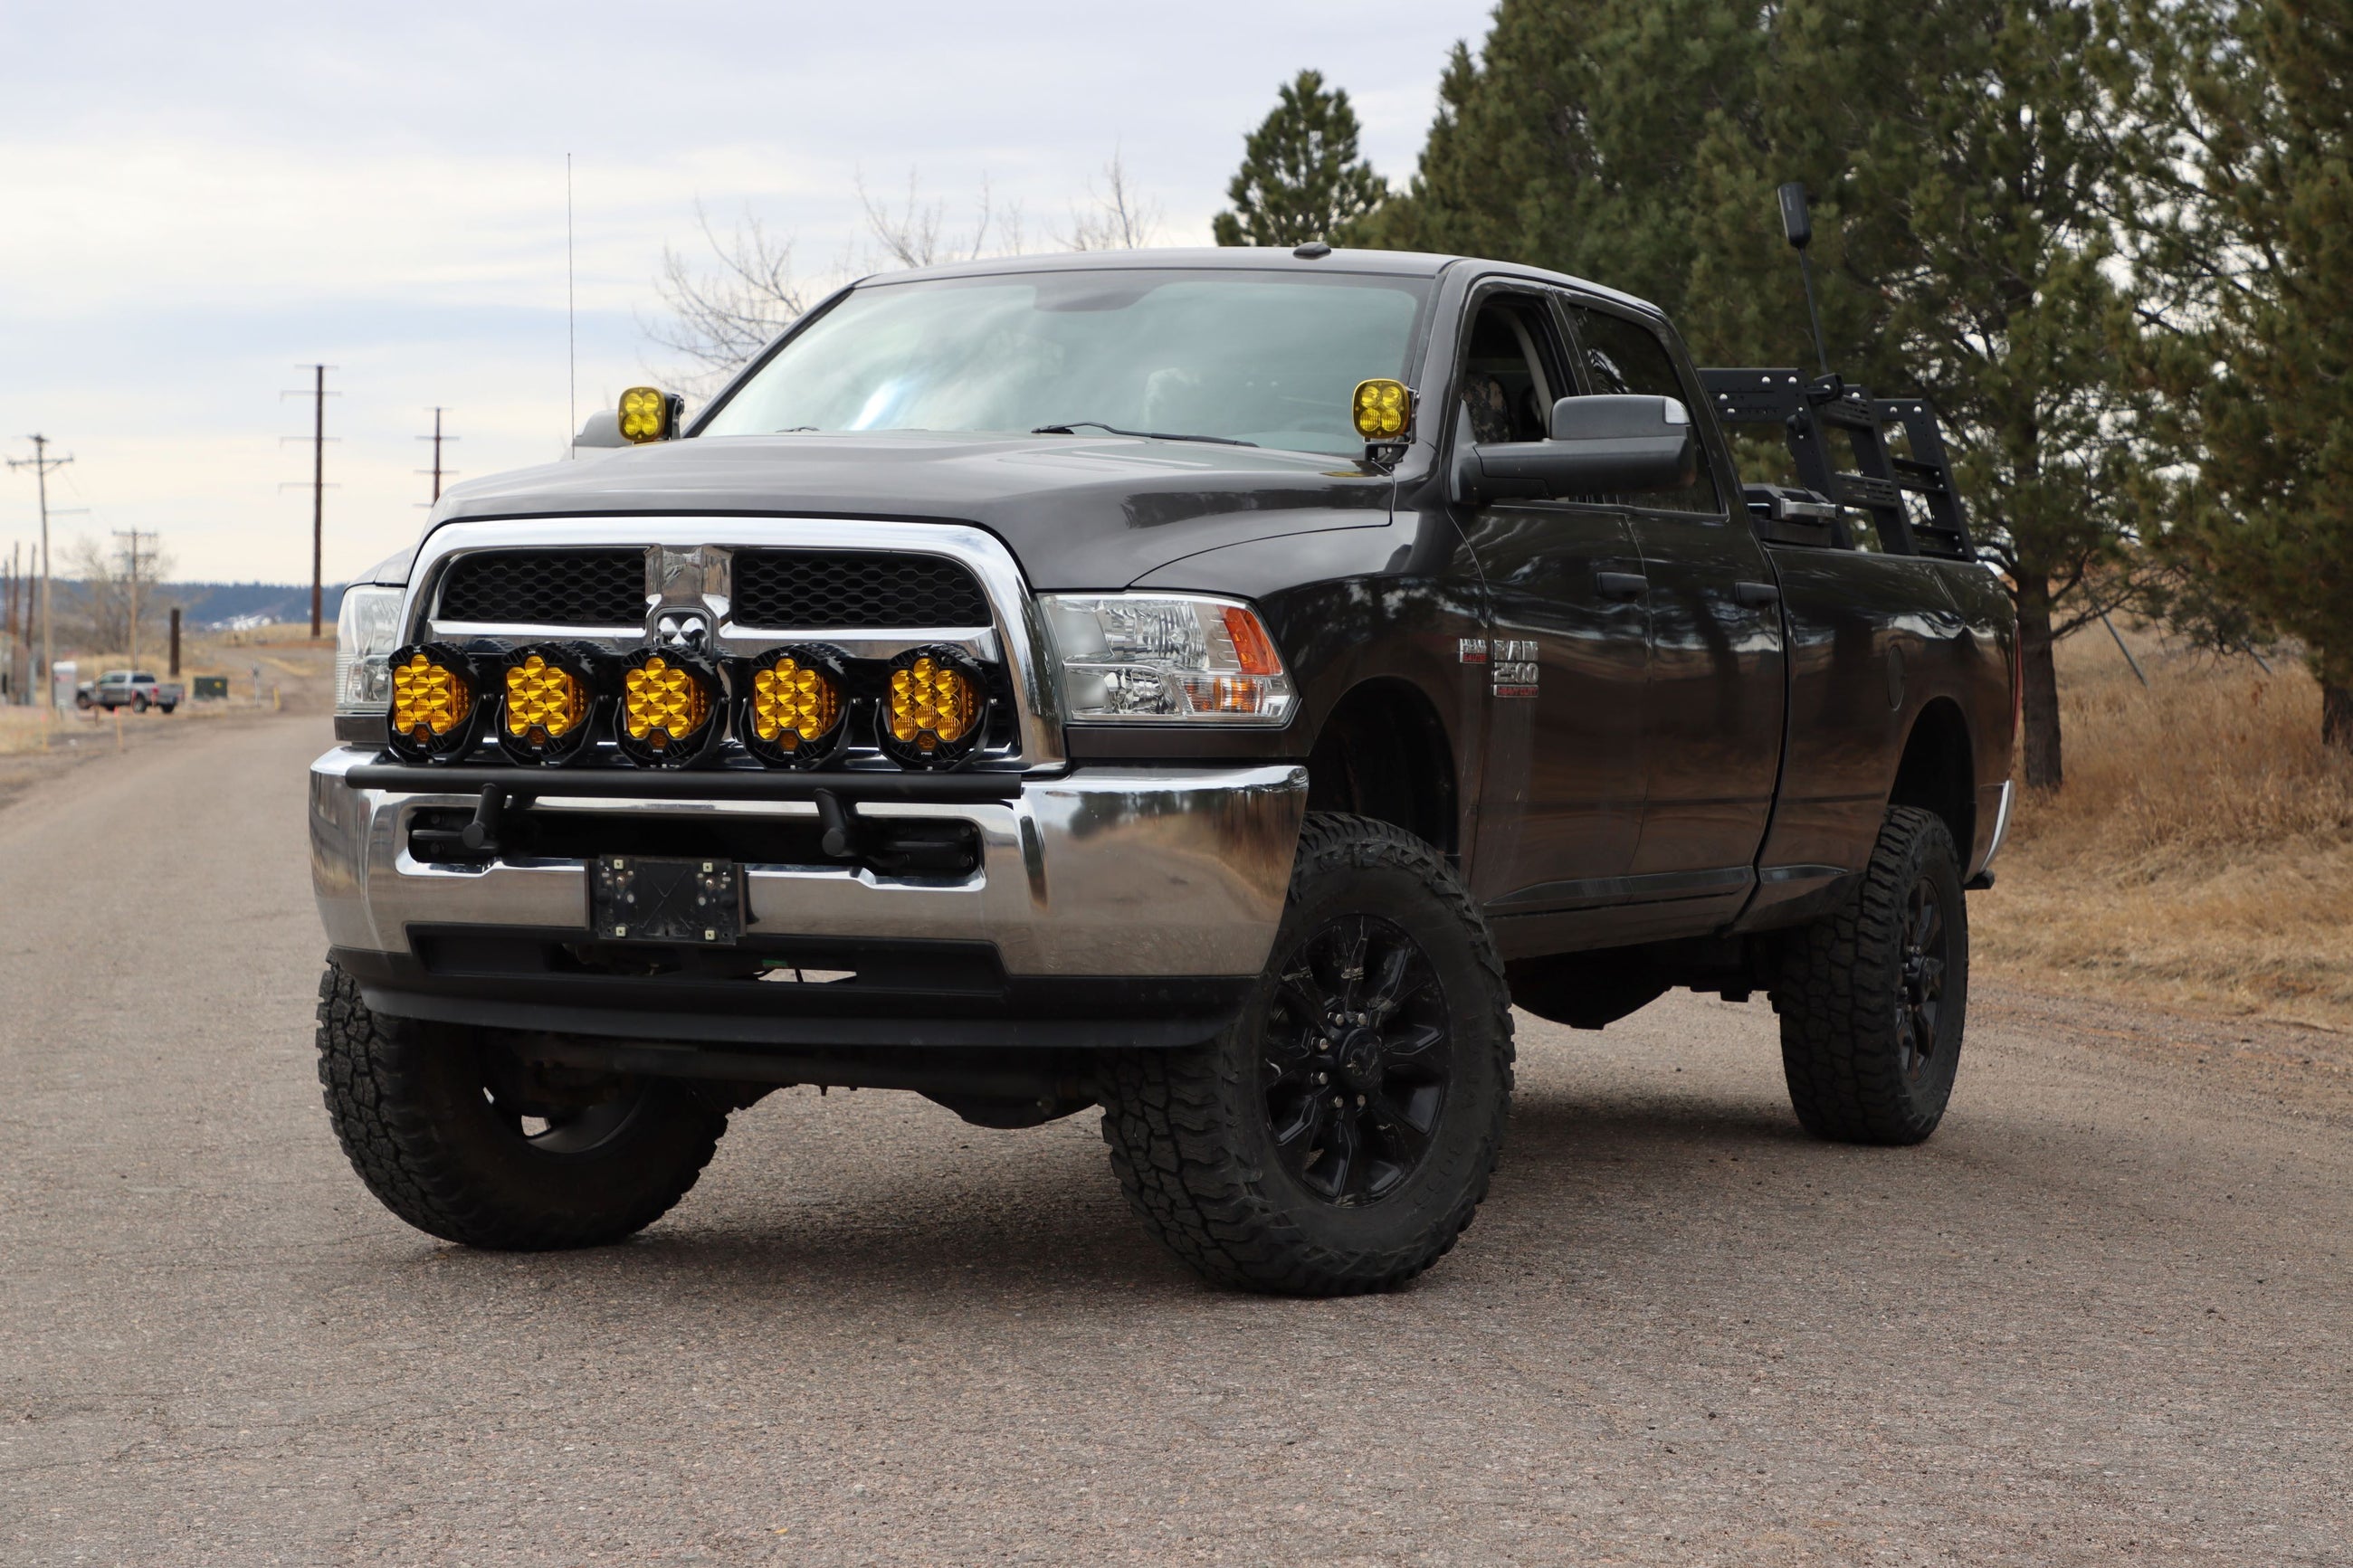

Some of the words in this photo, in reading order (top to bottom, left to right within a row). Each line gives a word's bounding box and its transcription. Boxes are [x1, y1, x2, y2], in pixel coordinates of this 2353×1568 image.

[1493, 639, 1538, 660] RAM
[1493, 661, 1538, 684] 2500
[1498, 687, 1519, 696] HEAVY
[1519, 687, 1538, 696] DUTY
